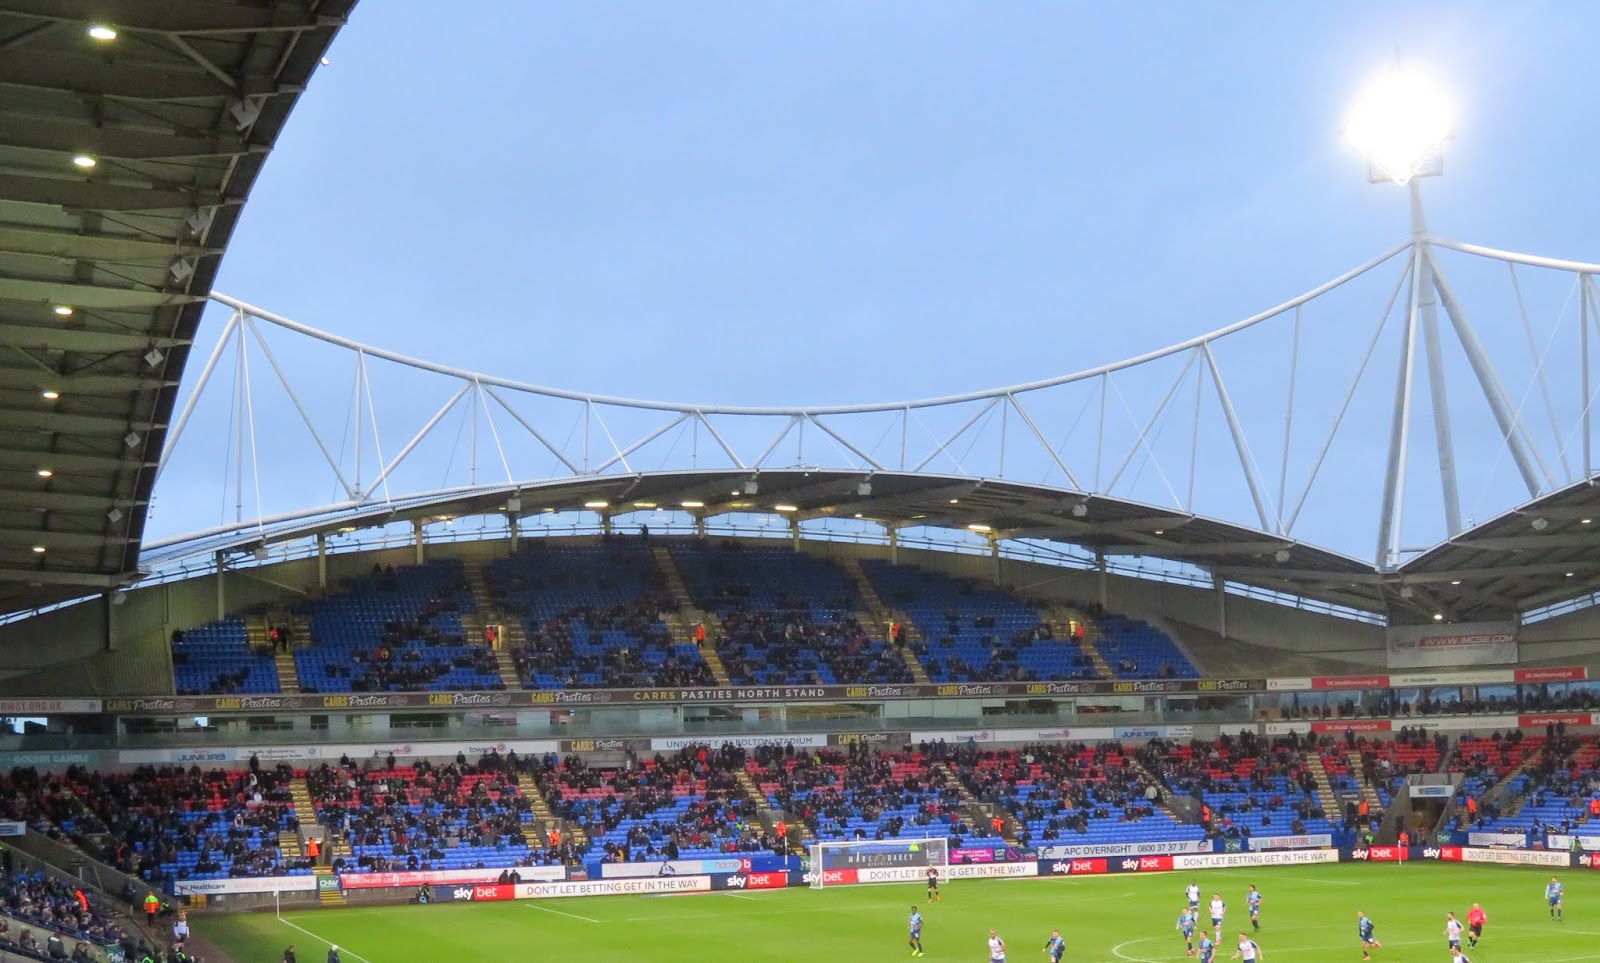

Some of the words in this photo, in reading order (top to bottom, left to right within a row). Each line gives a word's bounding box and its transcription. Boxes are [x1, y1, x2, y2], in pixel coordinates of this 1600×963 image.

[633, 691, 676, 700] CARRS
[681, 689, 732, 699] PASTIES
[738, 688, 780, 698] NORTH
[785, 688, 825, 697] STAND
[846, 687, 866, 697] CARRS
[867, 686, 902, 697] Pasties
[938, 685, 958, 696] CARRS
[958, 685, 991, 695] Pasties
[1027, 683, 1047, 694] CARRS
[1047, 683, 1079, 694] Pasties
[215, 698, 240, 709] CARRS
[241, 697, 281, 708] Pasties
[323, 695, 348, 707] CARRS
[349, 695, 387, 706] Pasties
[428, 694, 452, 705] CARRS
[453, 693, 491, 704] Pasties
[532, 692, 554, 703] CARRS
[555, 691, 592, 703] Pasties
[571, 740, 594, 751] CARRS
[596, 740, 624, 749] Pasties
[666, 739, 718, 748] UNIVERSITY
[736, 738, 771, 746] BOLTON
[774, 737, 813, 745] STADIUM
[178, 753, 226, 762] JUNIORS
[1064, 846, 1081, 856] APC
[1083, 845, 1132, 855] OVERNIGHT
[1138, 844, 1155, 853] 0800
[1157, 843, 1166, 852] 37
[1168, 843, 1177, 852] 37
[1179, 842, 1188, 851] 37
[1352, 848, 1369, 860] sky
[1372, 848, 1392, 858] bet
[1423, 847, 1440, 858] sky
[1442, 848, 1453, 858] bet
[848, 854, 872, 863] MARC
[887, 853, 913, 862] DARCY
[1184, 857, 1209, 866] DON'T
[1212, 856, 1225, 865] LET
[1228, 855, 1262, 864] BETTING
[1265, 854, 1280, 863] GET
[1282, 853, 1291, 862] IN
[1294, 853, 1308, 861] THE
[1311, 852, 1328, 860] WAY
[1469, 851, 1485, 859] DON'T
[1486, 851, 1495, 860] LET
[1496, 852, 1519, 861] BETTING
[1520, 853, 1530, 861] GET
[1531, 854, 1537, 862] IN
[1539, 854, 1549, 863] THE
[1551, 855, 1563, 863] WAY
[1579, 854, 1592, 866] sky
[1053, 861, 1071, 874] sky
[1074, 861, 1092, 871] bet
[1122, 858, 1139, 870] sky
[1142, 858, 1159, 868] bet
[803, 872, 820, 884] sky
[824, 871, 842, 881] bet
[870, 869, 897, 880] DON'T
[901, 868, 915, 879] LET
[958, 867, 974, 876] GET
[977, 866, 986, 875] IN
[989, 865, 1005, 875] THE
[1007, 864, 1026, 874] WAY
[190, 882, 226, 890] Healthcare
[527, 885, 557, 895] DON'T
[560, 884, 577, 894] LET
[580, 882, 621, 894] BETTING
[625, 881, 642, 891] GET
[645, 880, 655, 890] IN
[657, 879, 675, 890] THE
[678, 878, 699, 889] WAY
[727, 875, 746, 888] sky
[750, 875, 769, 885] bet
[453, 887, 474, 900] sky
[477, 886, 497, 897] bet
